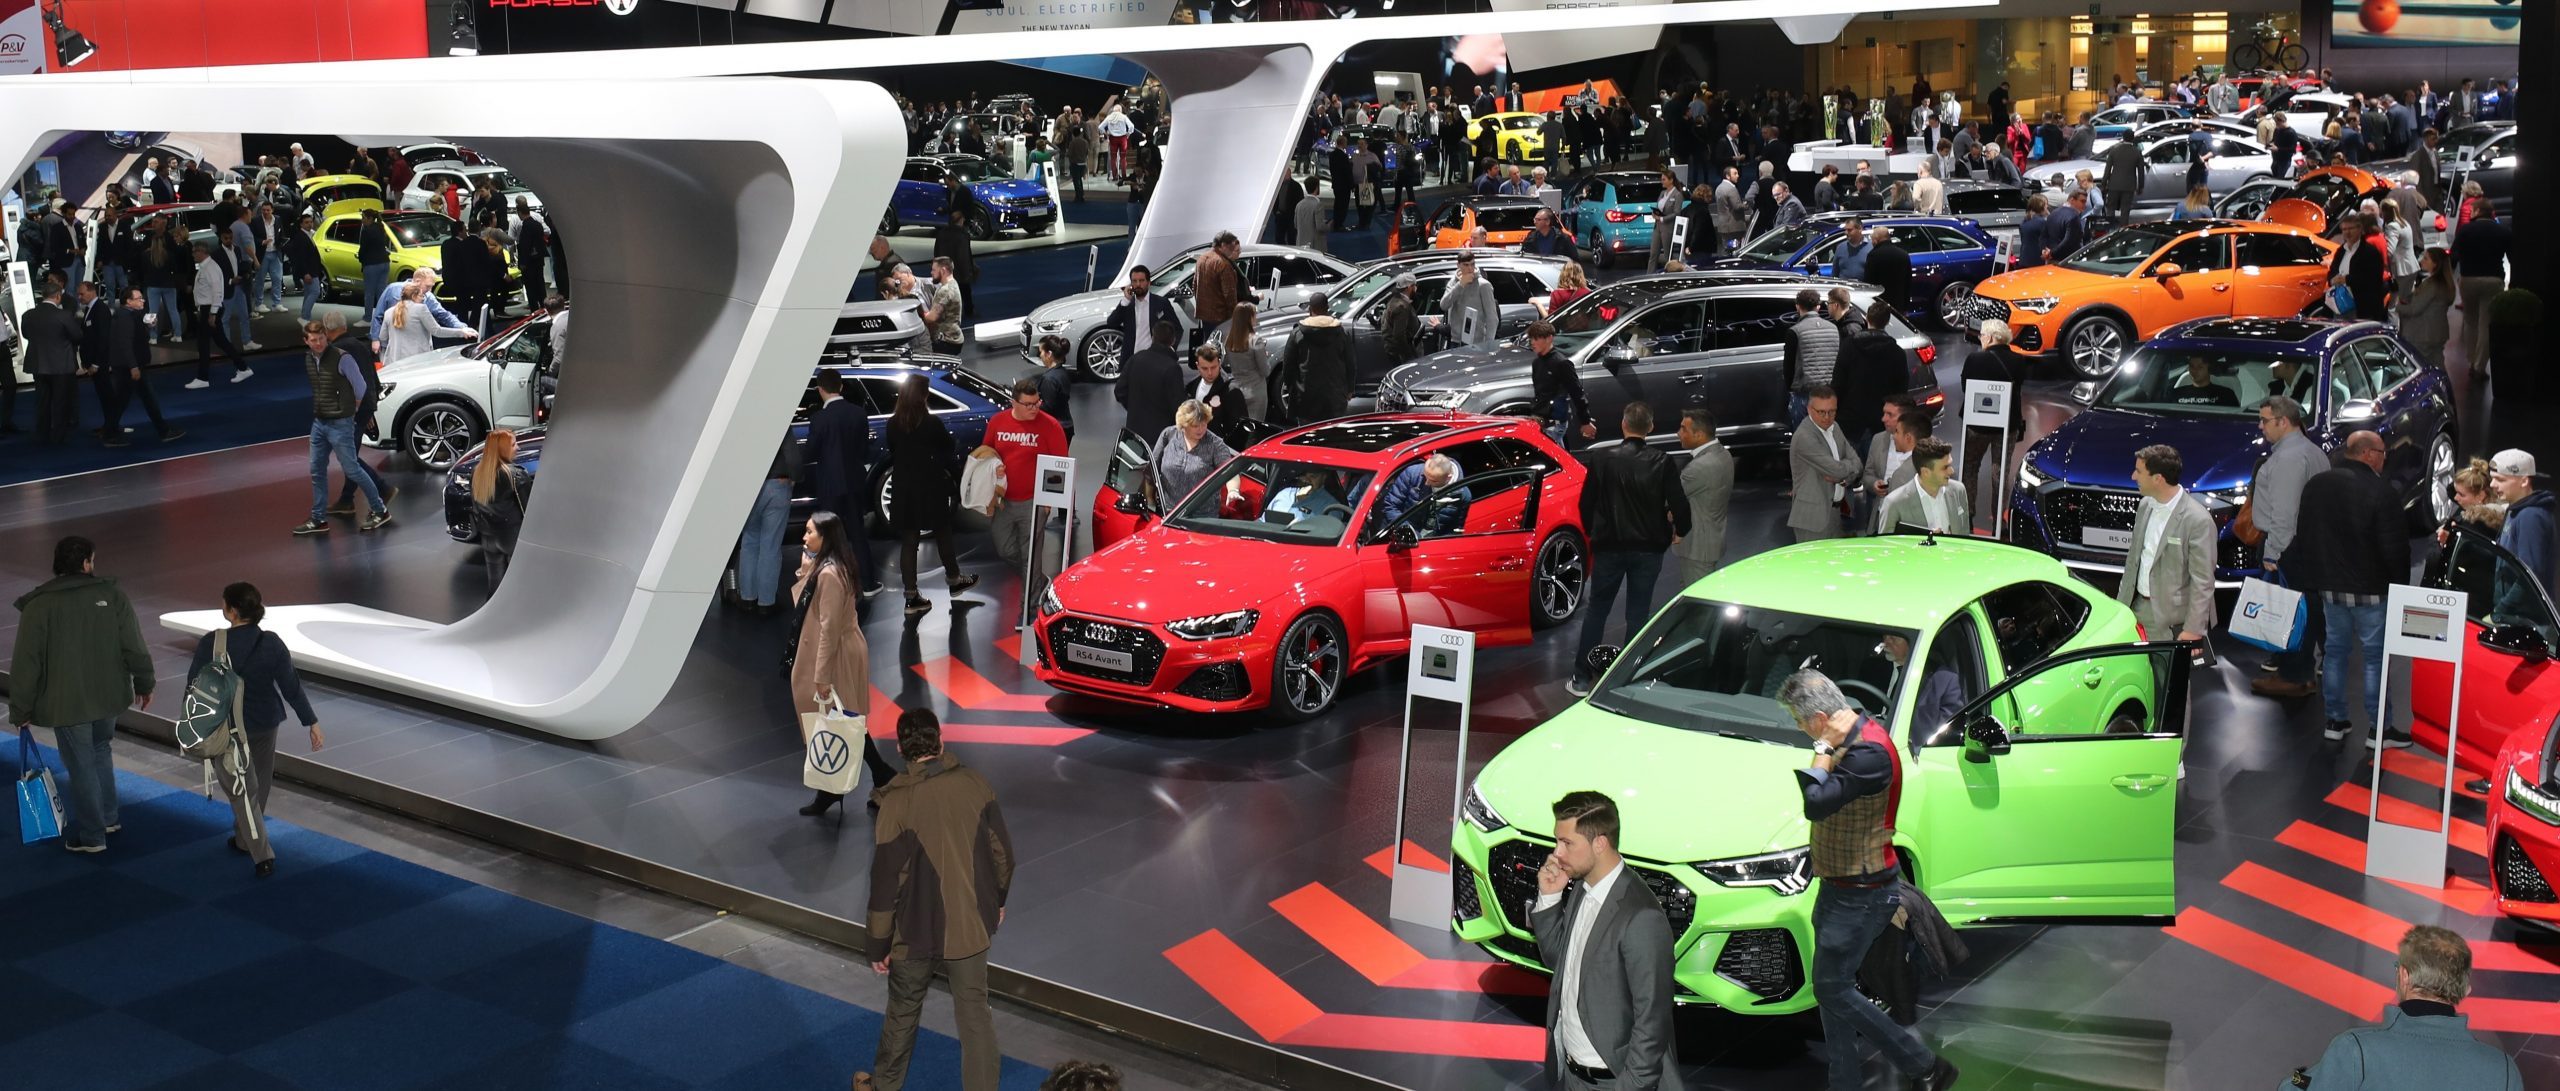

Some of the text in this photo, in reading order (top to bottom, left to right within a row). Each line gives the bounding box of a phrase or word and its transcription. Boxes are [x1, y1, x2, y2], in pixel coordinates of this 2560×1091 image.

[1, 42, 24, 53] P&V
[997, 432, 1039, 443] TOMMY
[2109, 535, 2119, 543] RS
[1076, 650, 1122, 666] RS4 Avant
